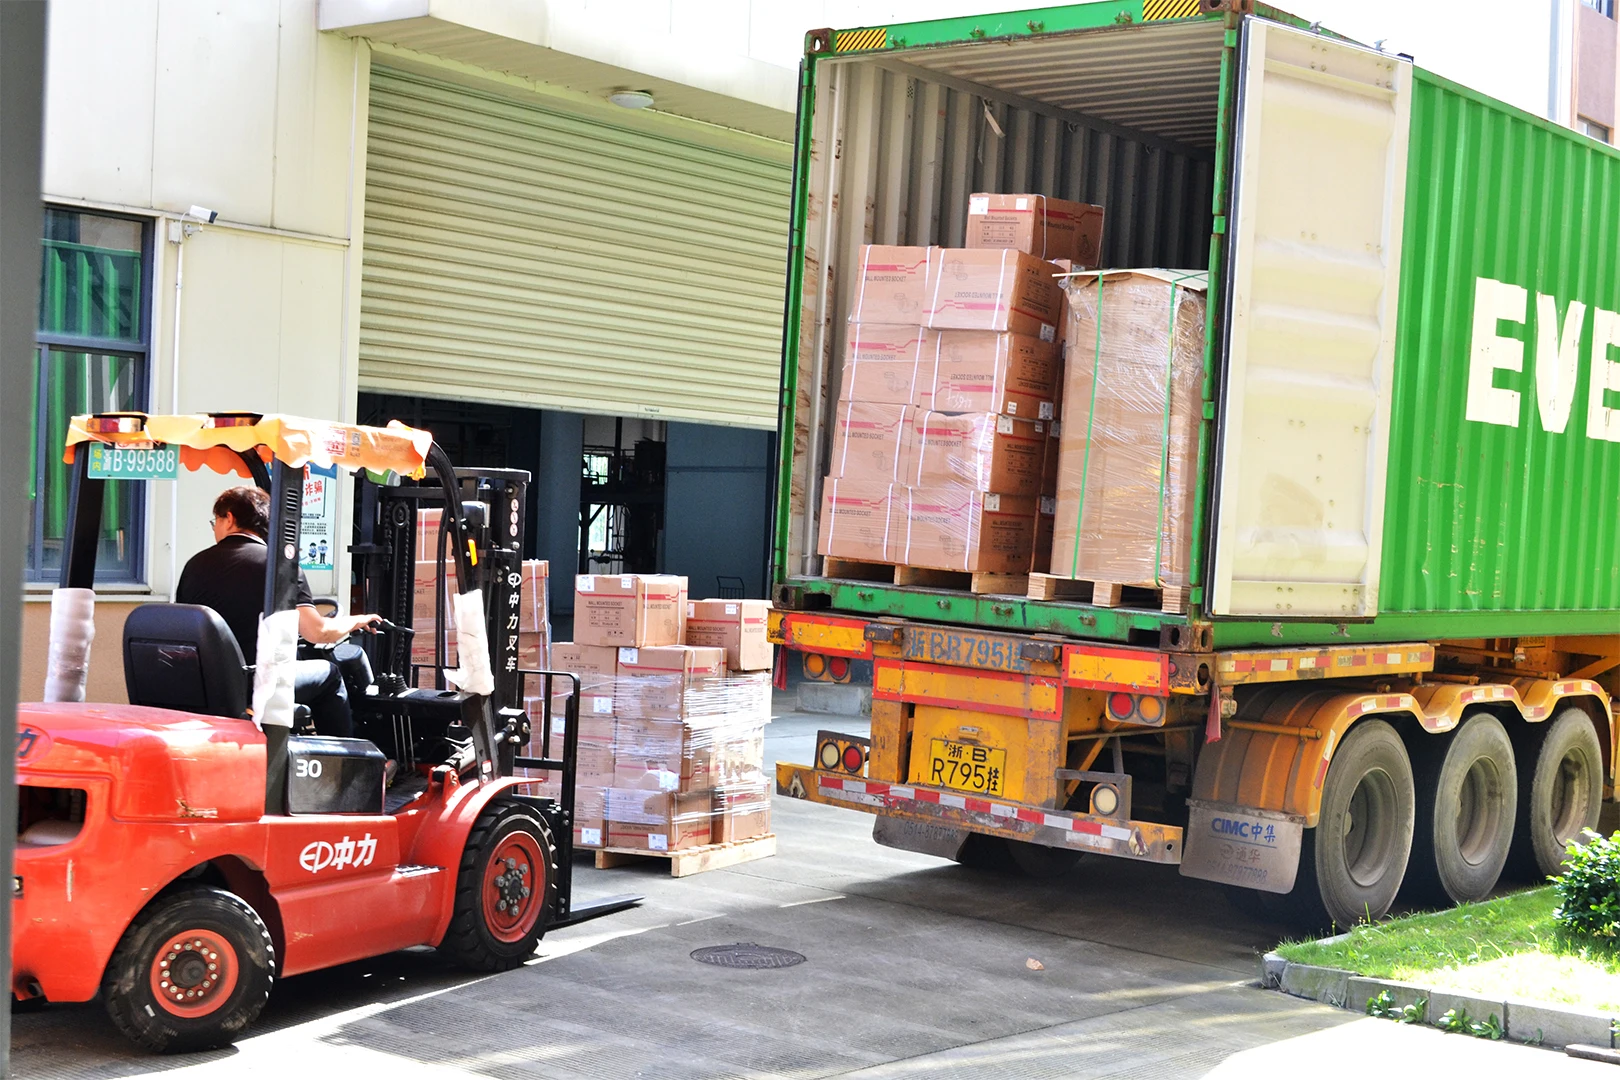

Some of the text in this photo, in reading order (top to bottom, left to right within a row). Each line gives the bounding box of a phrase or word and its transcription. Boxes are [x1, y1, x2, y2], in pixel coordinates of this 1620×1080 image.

[1466, 276, 1620, 443] EVE
[869, 433, 884, 441] SOCKET
[505, 592, 519, 673] 中力叉车
[296, 759, 322, 778] 30
[931, 757, 1000, 792] R795挂
[1211, 817, 1276, 843] CIMC 中集
